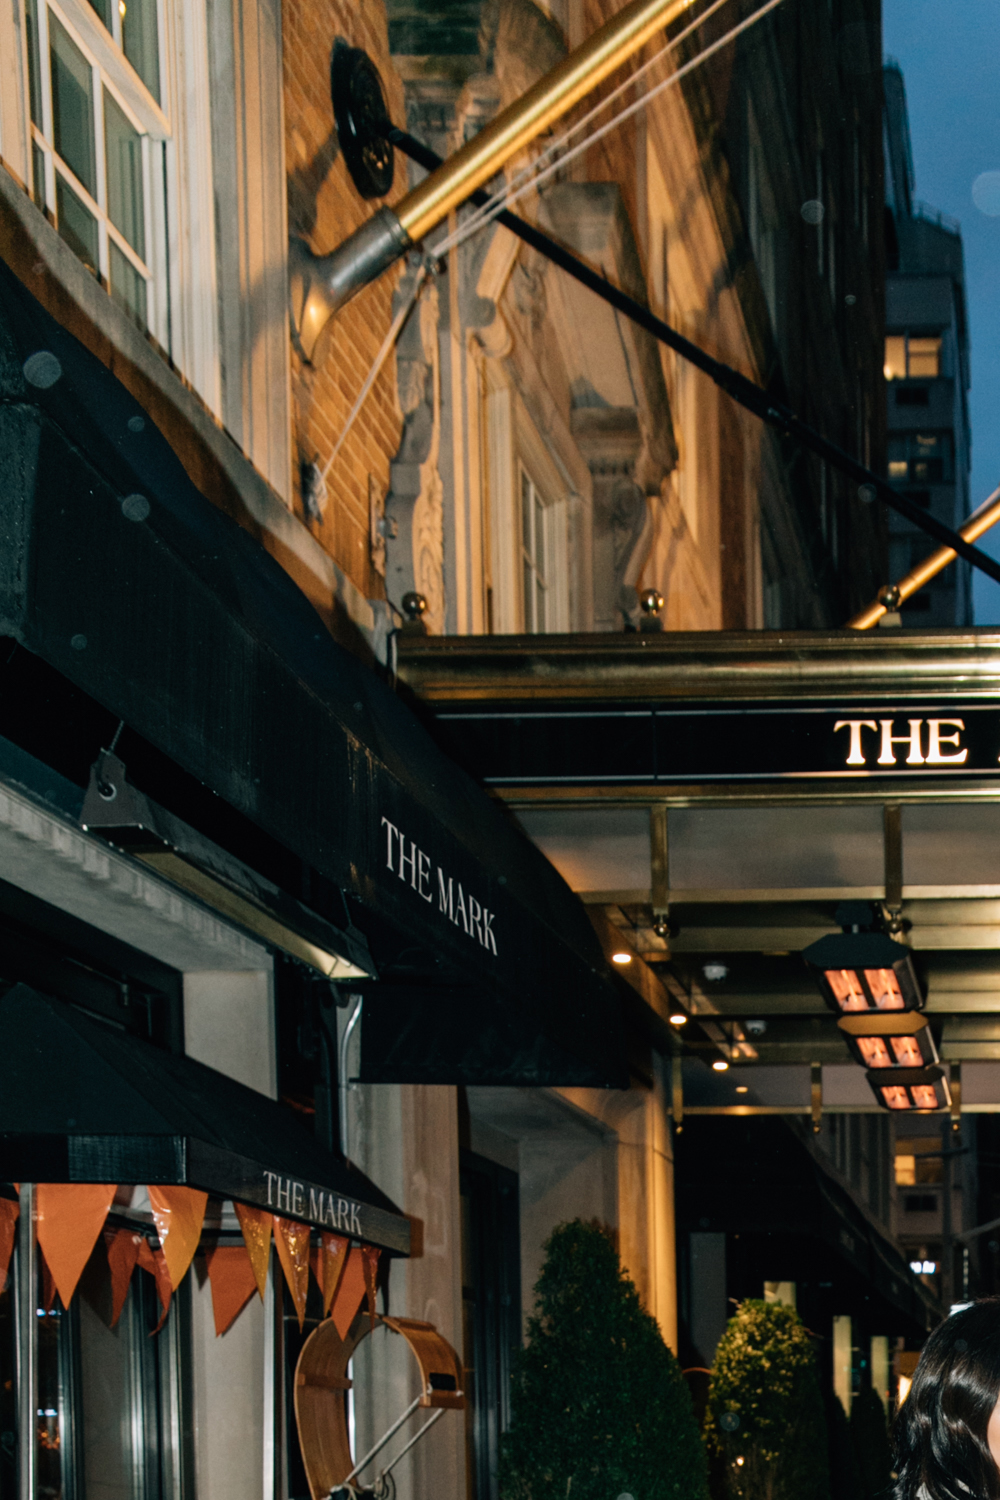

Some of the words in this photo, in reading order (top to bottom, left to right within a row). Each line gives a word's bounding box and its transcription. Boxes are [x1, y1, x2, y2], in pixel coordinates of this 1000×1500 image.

[833, 718, 968, 764] THE
[381, 816, 433, 903] THE
[437, 866, 498, 956] MARK
[263, 1170, 304, 1217] THE
[309, 1187, 362, 1236] MARK
